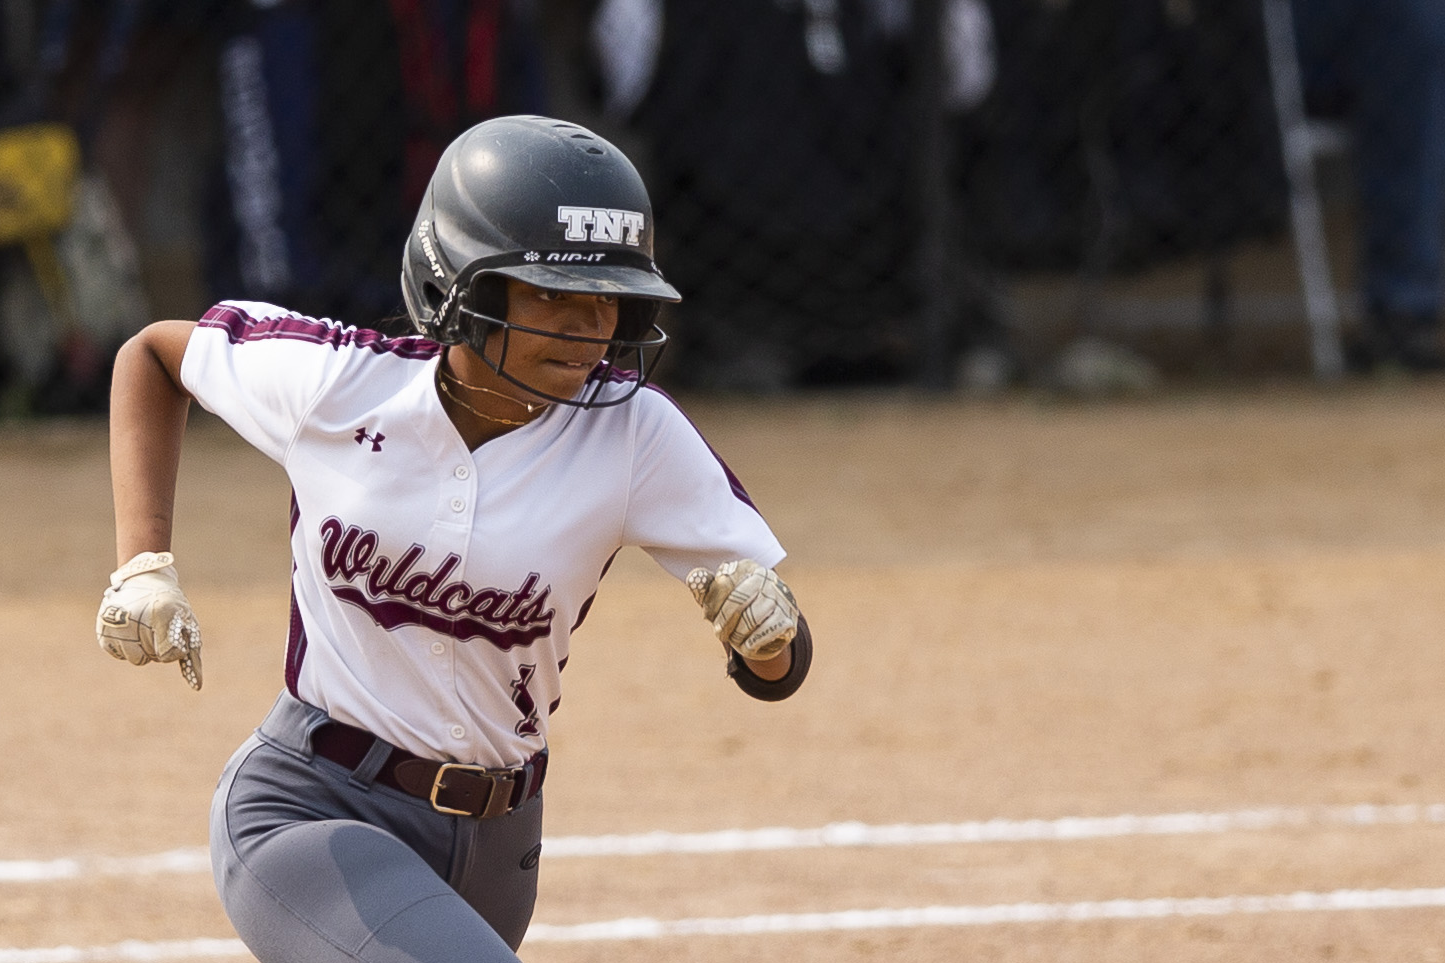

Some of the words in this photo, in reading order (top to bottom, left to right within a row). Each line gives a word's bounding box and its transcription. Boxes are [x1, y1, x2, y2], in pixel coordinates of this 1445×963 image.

[558, 206, 644, 246] TNT
[546, 253, 606, 262] RIP-IT
[319, 515, 556, 632] Wildcats
